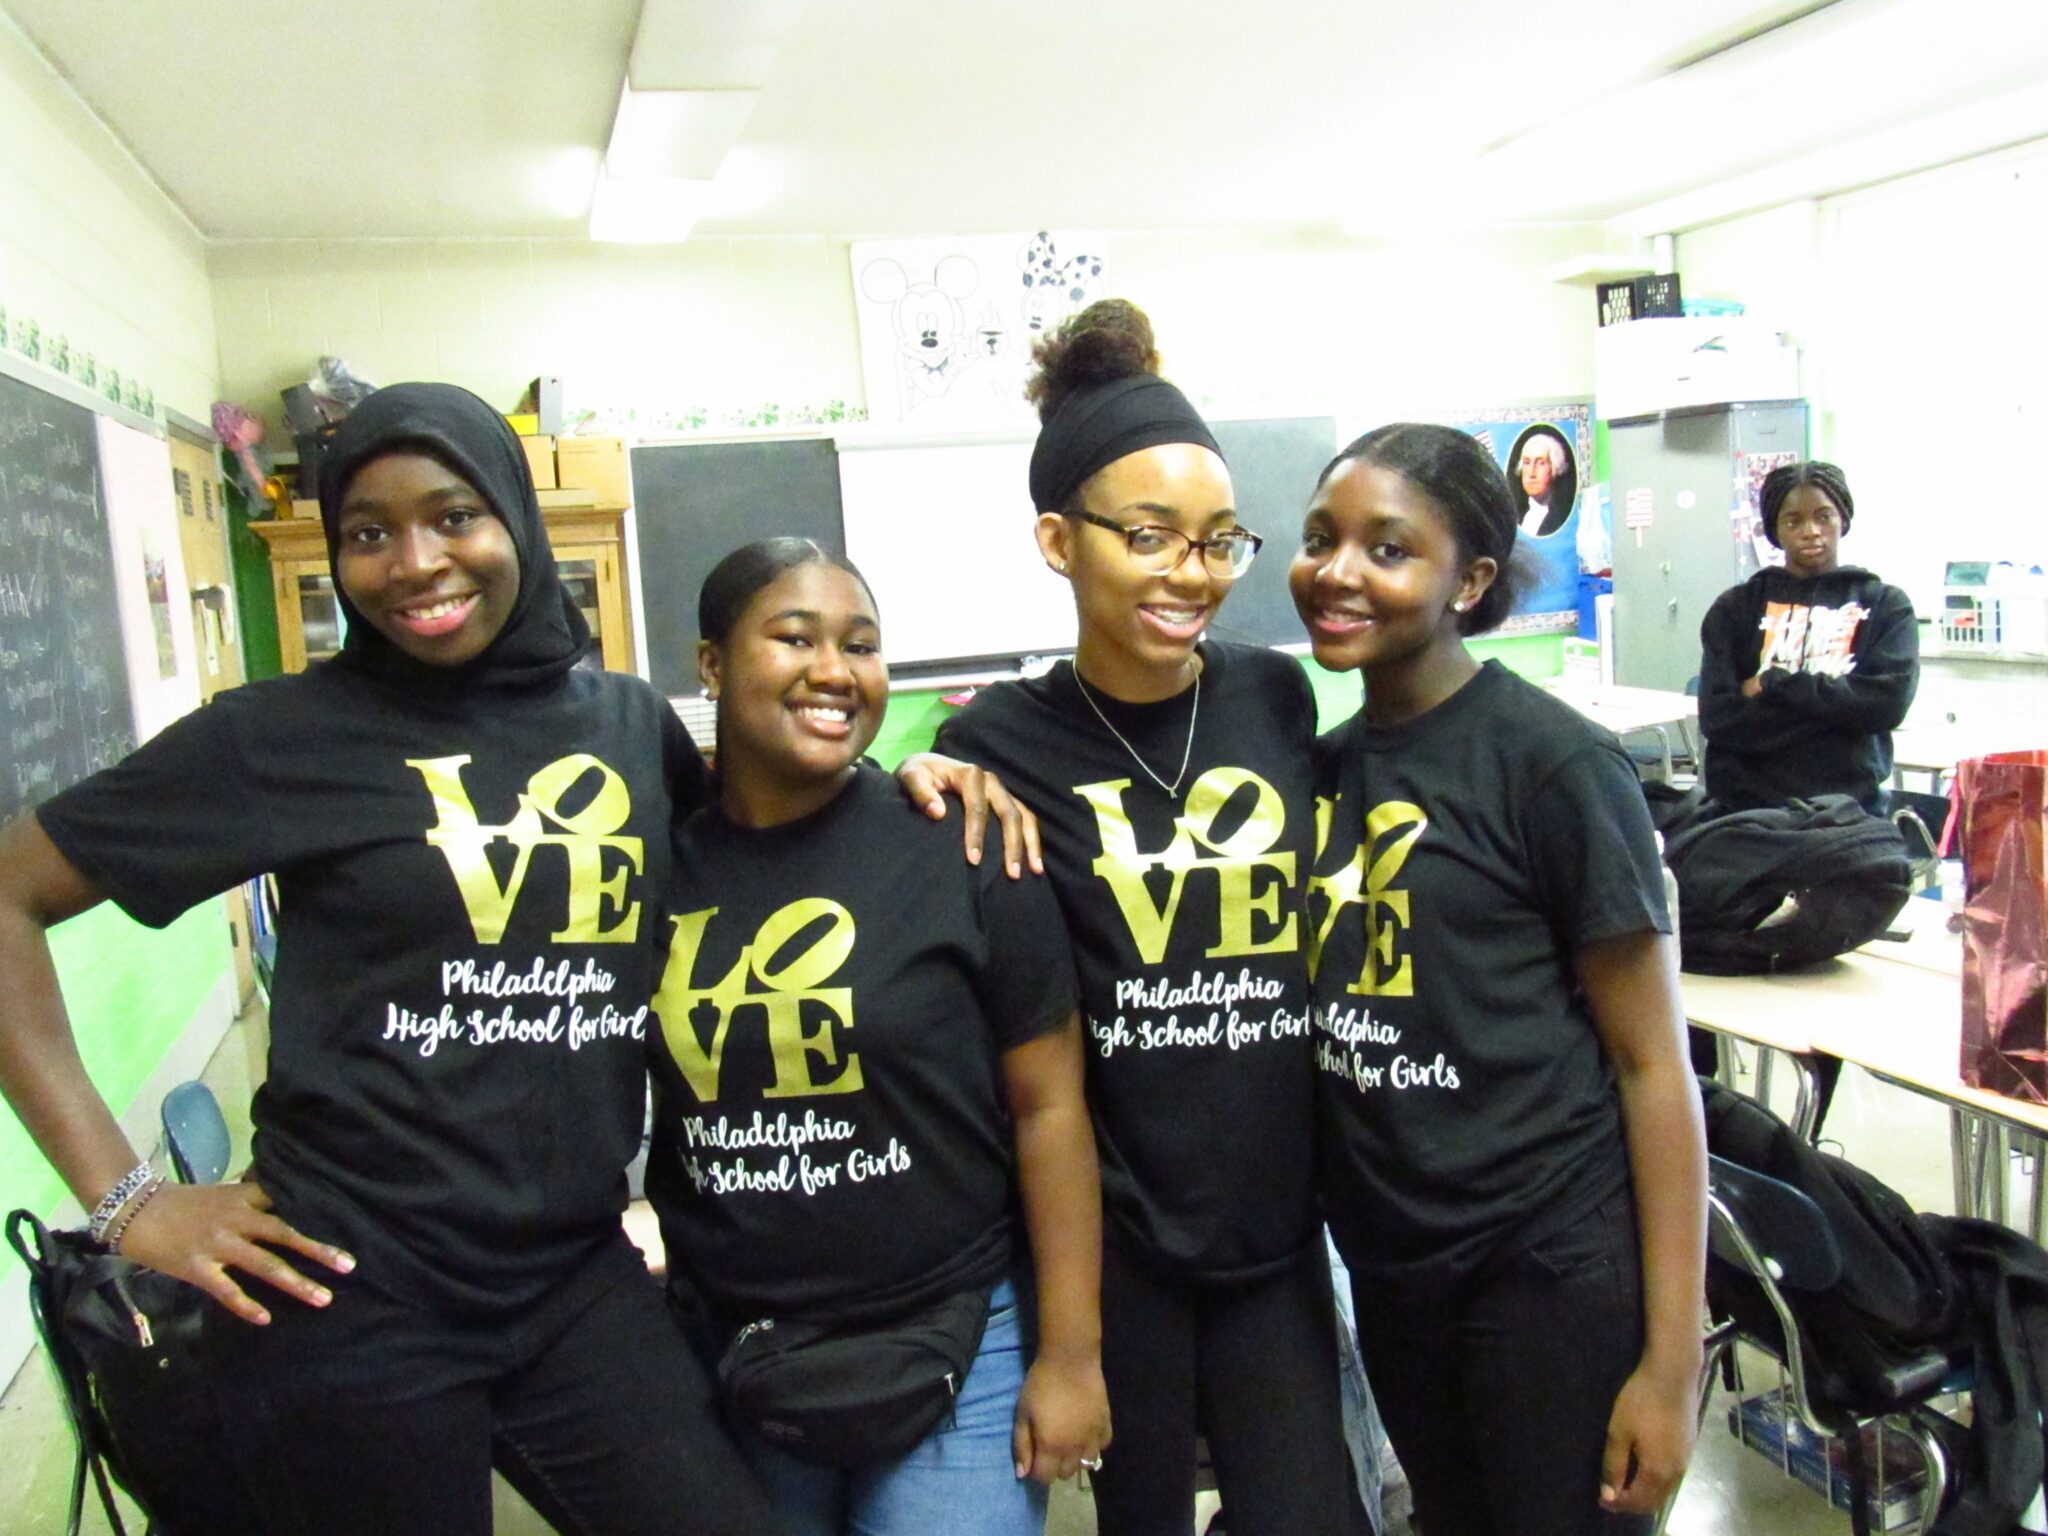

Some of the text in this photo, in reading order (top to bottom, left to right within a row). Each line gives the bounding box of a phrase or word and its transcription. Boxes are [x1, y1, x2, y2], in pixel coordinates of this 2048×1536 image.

[442, 956, 616, 1007] Philadelphia
[1116, 968, 1285, 1012] Philadelphia
[382, 1003, 648, 1057] High School for Girl
[1088, 1014, 1136, 1057] igh
[1137, 1012, 1225, 1050] School
[1226, 1010, 1267, 1050] for
[1353, 1052, 1385, 1094] for
[1390, 1053, 1461, 1090] Girls
[682, 1110, 856, 1156] Philadelphia
[708, 1154, 797, 1194] School
[800, 1155, 841, 1195] for
[847, 1138, 912, 1182] Girls
